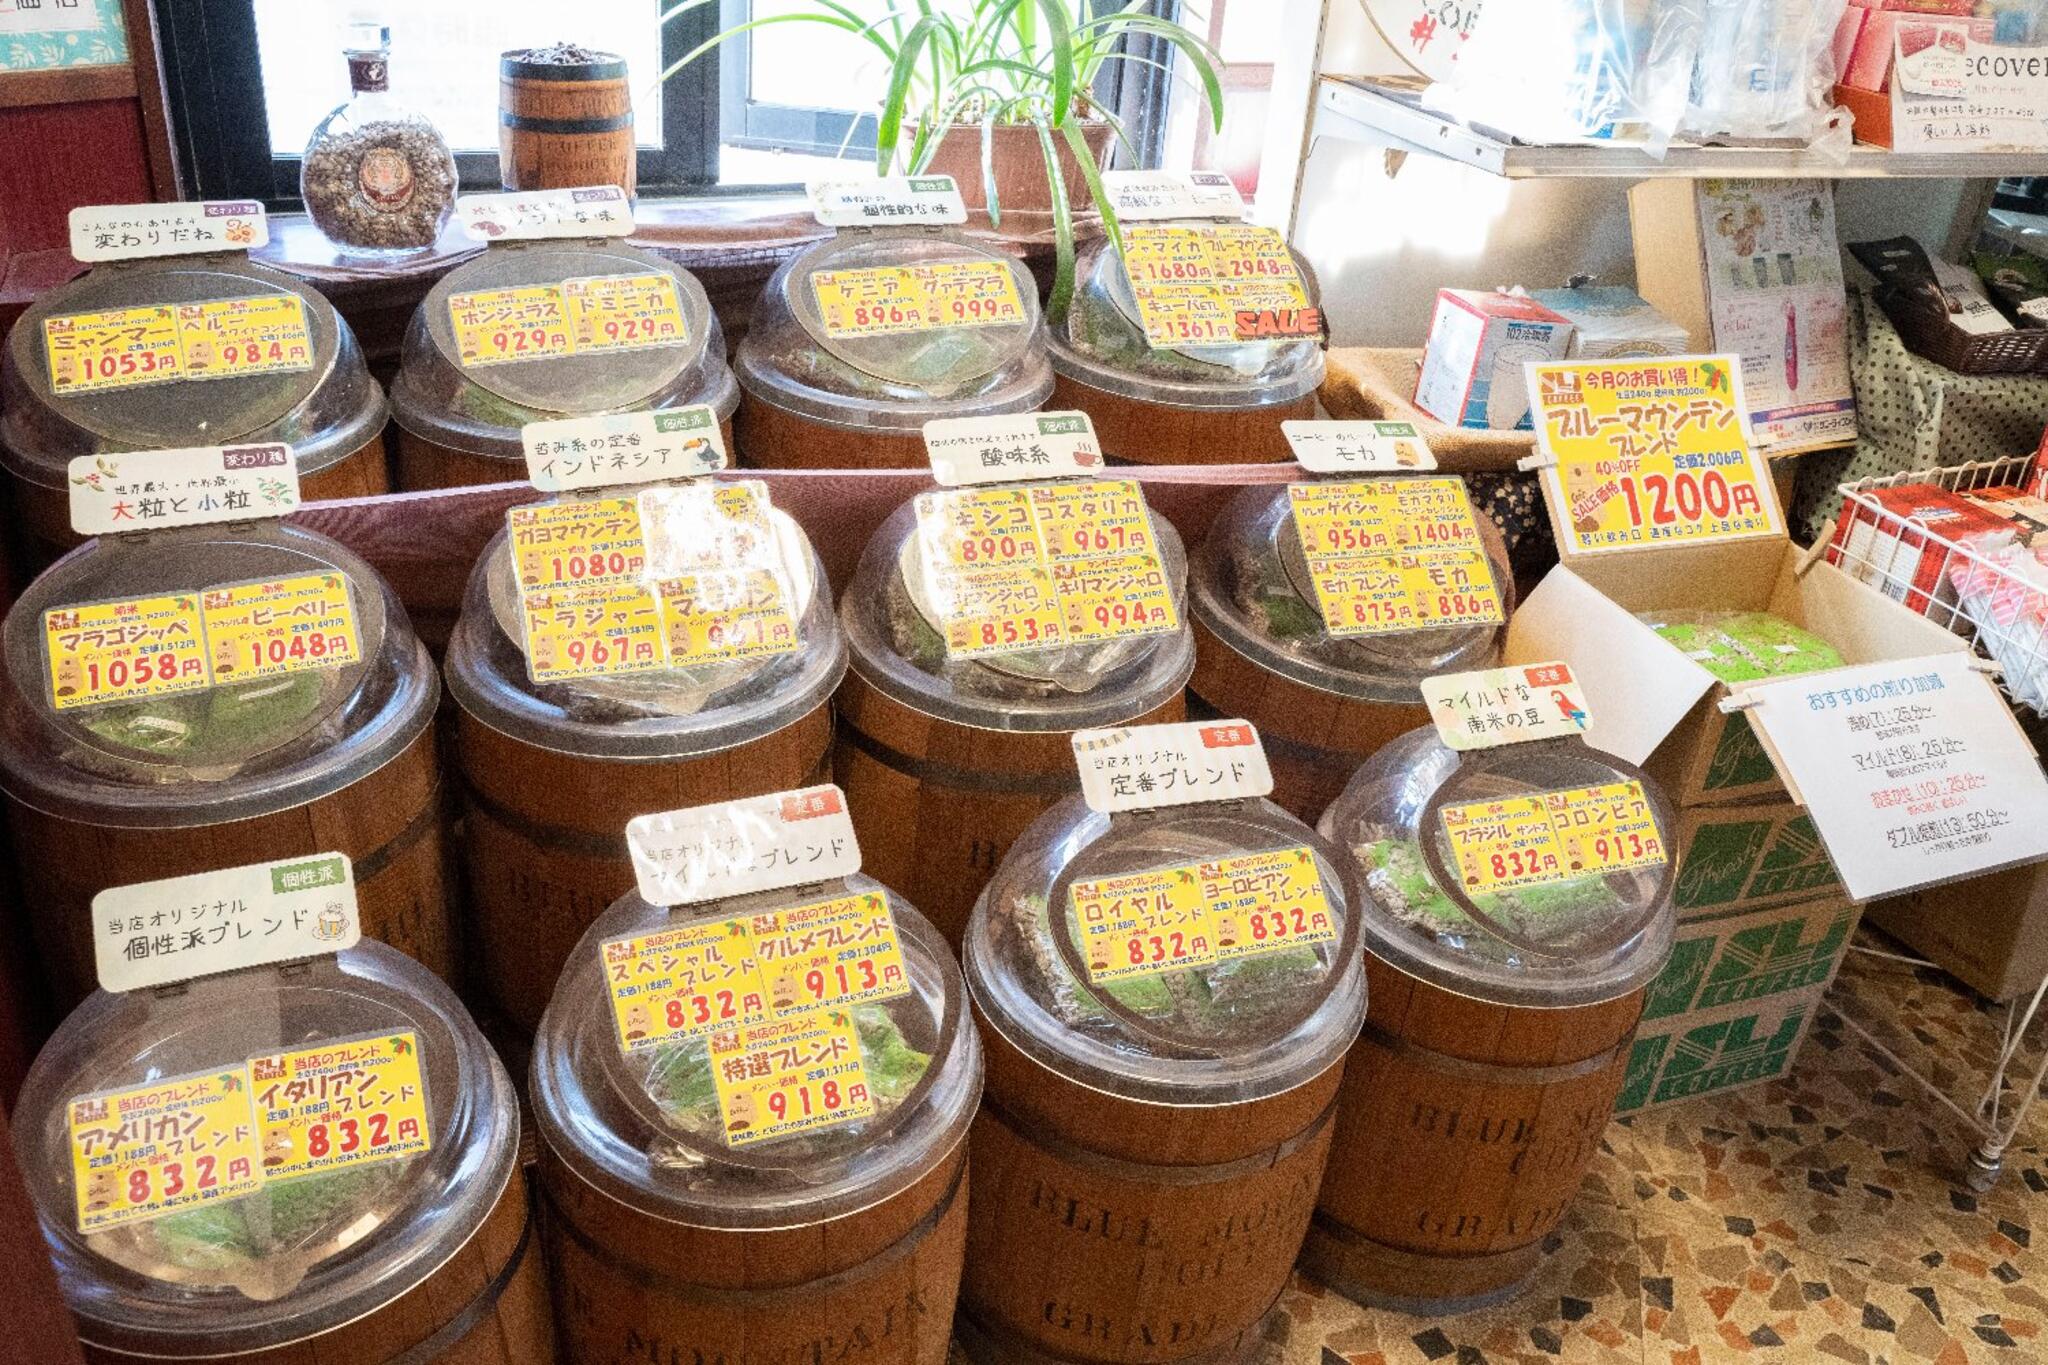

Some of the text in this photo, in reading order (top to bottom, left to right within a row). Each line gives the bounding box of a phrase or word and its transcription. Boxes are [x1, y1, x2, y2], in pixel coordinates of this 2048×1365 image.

[863, 203, 949, 217] 個性的な味
[95, 227, 216, 248] 変わりだね
[1123, 241, 1201, 253] ジャマイカ
[1206, 240, 1283, 253] ブルーマウンテン
[1148, 261, 1212, 280] 1680円
[1229, 259, 1293, 276] 2948円
[840, 282, 899, 299] ケニア
[924, 275, 1005, 295] グァテマラ
[461, 303, 561, 326] ホンジュラス
[581, 293, 664, 314] ドミニカ
[855, 305, 921, 327] 896円
[952, 298, 1015, 319] 999円
[184, 317, 245, 332] ペルー
[218, 323, 302, 339] ホワイトコンドル
[604, 318, 676, 341] 929円
[1166, 319, 1231, 338] 1361円
[1234, 307, 1320, 338] SALE
[54, 326, 174, 350] ミャンマー
[493, 328, 567, 353] 929円
[83, 352, 177, 381] 1053円
[223, 342, 306, 366] 984円
[1585, 367, 1699, 389] 今月のお買い得！
[1546, 400, 1735, 438] ブルーマウンテン
[534, 433, 642, 456] 苦み系の定番
[979, 443, 1051, 467] 酸味系
[1336, 445, 1376, 461] モカ
[1609, 432, 1678, 457] ブレンド
[225, 450, 285, 468] 変わり種
[541, 447, 672, 479] インドネシア
[111, 489, 252, 521] 大粒と小粒
[1037, 497, 1140, 521] コスタリカ
[1327, 500, 1379, 516] ゲイシャ
[1399, 494, 1456, 507] モカマタリ
[1571, 479, 1620, 521] SALE価格
[1620, 470, 1762, 527] 1200円
[516, 518, 641, 545] ガヨマウンテン
[1073, 526, 1146, 551] 967円
[1327, 528, 1388, 549] 956円
[1413, 522, 1475, 544] 1404円
[961, 535, 1037, 562] 890円
[553, 552, 644, 581] 1080円
[1428, 567, 1469, 587] モカ
[1058, 571, 1163, 596] キリマンジャロ
[1321, 574, 1401, 594] モカブレンド
[252, 599, 345, 626] ピーベリー
[996, 599, 1057, 615] ブレンド
[1094, 601, 1167, 628] 994円
[1354, 601, 1413, 623] 875円
[1438, 595, 1496, 617] 886円
[530, 607, 655, 633] トラジャー
[981, 617, 1060, 645] 853円
[58, 619, 190, 652] マラゴジッペ
[252, 632, 348, 667] 1048円
[568, 637, 654, 666] 967円
[88, 653, 203, 691] 1058円
[1438, 683, 1531, 710] マイルドな
[1806, 672, 1945, 711] おすすめの煎り加減
[1467, 707, 1545, 734] 南米の豆
[1213, 729, 1241, 743] 定番
[1110, 762, 1245, 798] 定番ブレンド
[1554, 800, 1645, 829] コロンビア
[1454, 824, 1512, 845] ブラジル
[1595, 833, 1660, 863] 913円
[280, 865, 335, 888] 個性派
[1490, 848, 1559, 879] 832円
[1204, 872, 1290, 900] ヨーロピアン
[1265, 883, 1322, 903] ブレンド
[108, 898, 249, 936] 当店オリジナル
[786, 899, 857, 924] 当店のブレンド
[1084, 892, 1174, 922] ロイヤル
[1143, 908, 1202, 929] ブレンド
[122, 907, 311, 963] 個性派ブレンド
[1250, 907, 1328, 940] 832円
[758, 916, 890, 961] グルメブレンド
[1127, 932, 1209, 965] 832円
[612, 945, 724, 982] スペシャル
[680, 958, 756, 986] ブレンド
[805, 958, 902, 1000] 913円
[1714, 964, 1819, 1005] COFFEE
[665, 989, 763, 1029] 832円
[746, 1017, 817, 1042] 当店のブレンド
[294, 1045, 382, 1071] 当店のブレンド
[721, 1036, 850, 1084] 特選ブレンド
[258, 1070, 379, 1110] イタリアン
[1669, 1057, 1774, 1099] COFFEE
[118, 1083, 210, 1112] 当店のブレンド
[336, 1085, 415, 1114] ブレンド
[768, 1080, 868, 1121] 918円
[76, 1110, 206, 1156] アメリカン
[166, 1125, 249, 1156] ブレンド
[307, 1112, 420, 1159] 832円
[128, 1155, 251, 1204] 832円
